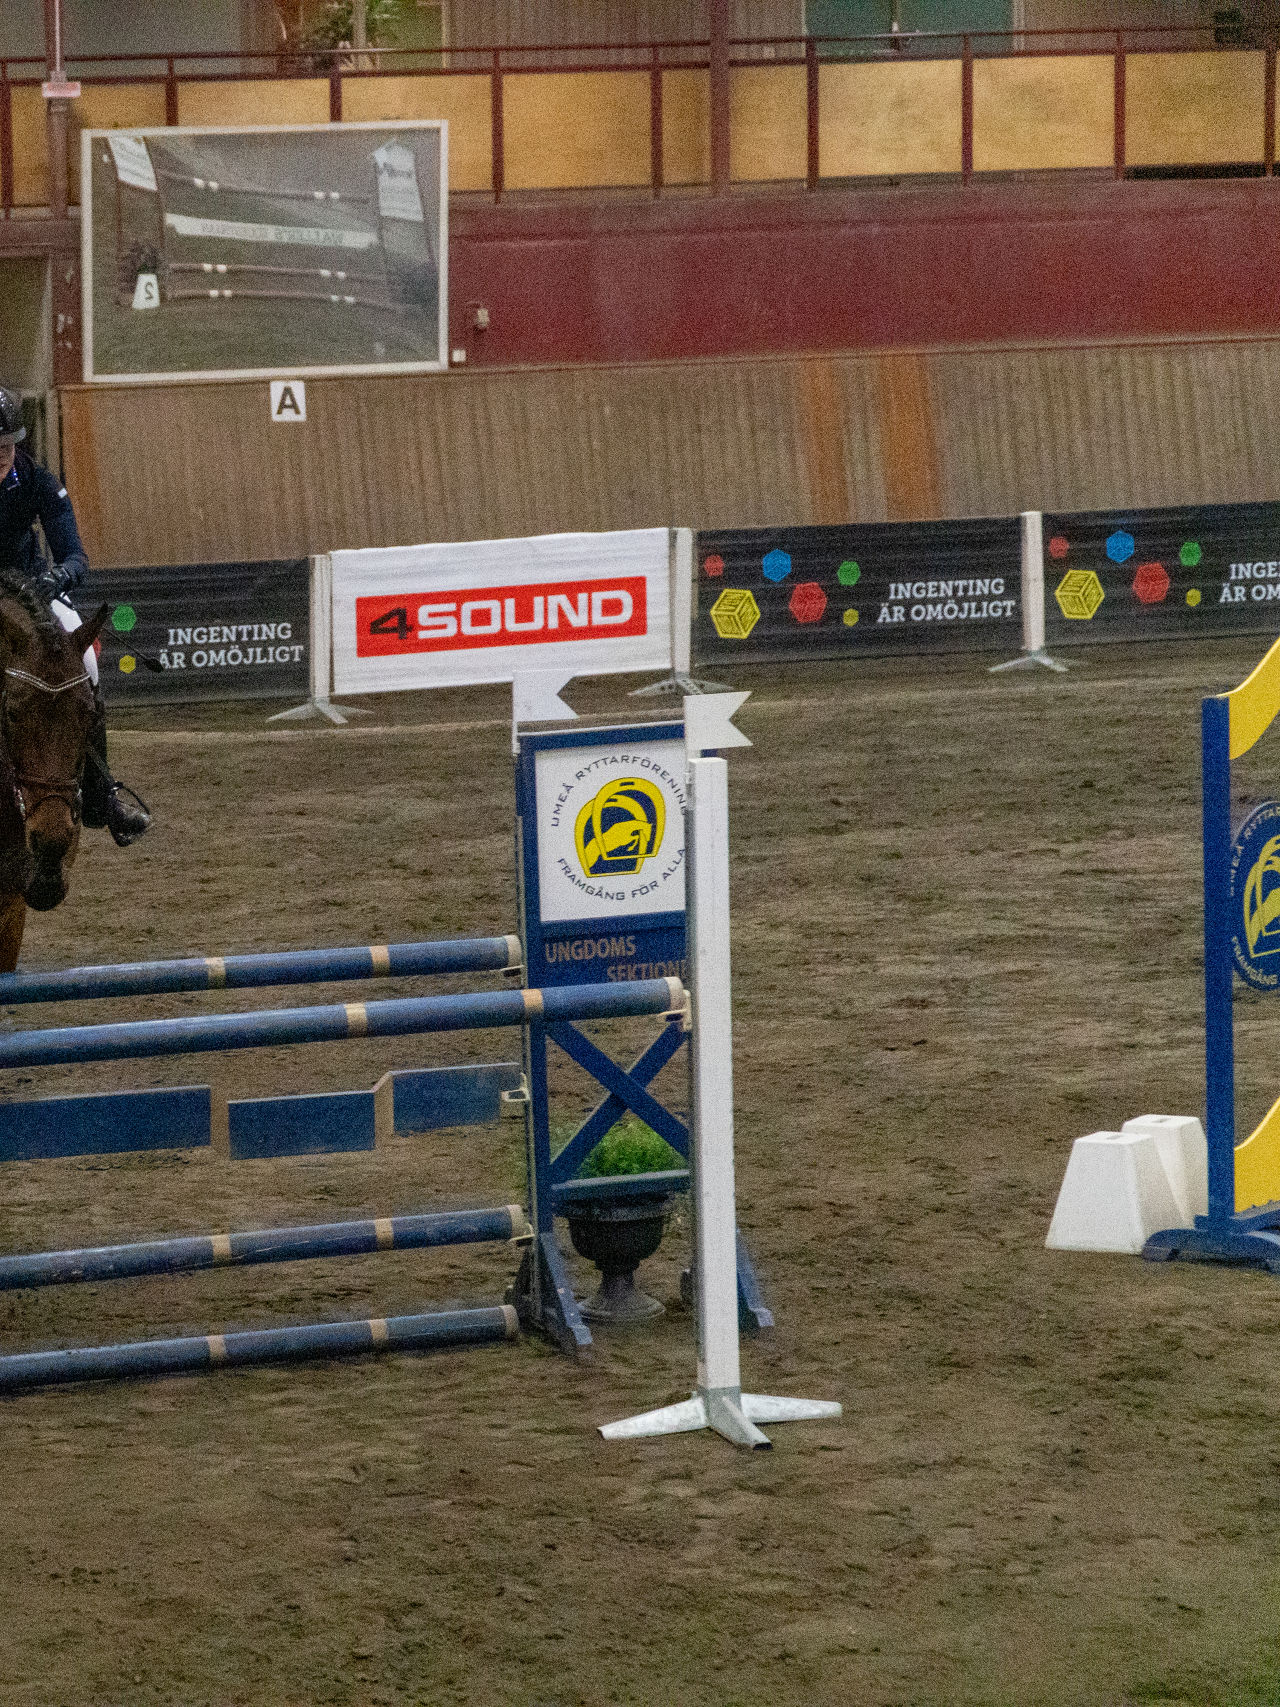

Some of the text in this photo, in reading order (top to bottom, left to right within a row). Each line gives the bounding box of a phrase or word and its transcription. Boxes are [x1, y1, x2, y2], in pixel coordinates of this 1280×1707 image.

[276, 386, 301, 415] A
[1229, 561, 1280, 580] INGE
[888, 578, 1006, 600] INGENTING
[1219, 582, 1247, 603] ÄR
[369, 589, 634, 641] 4SOUND
[877, 599, 1016, 623] ÄR OMÖJLIGT
[168, 622, 292, 646] INGENTING
[159, 645, 304, 669] ÄR OMÖJLIGT
[551, 783, 574, 827] UMEÅ
[556, 848, 686, 901] FRAMGÅNG FÖR ALLA
[545, 935, 636, 963] UNGDOMS
